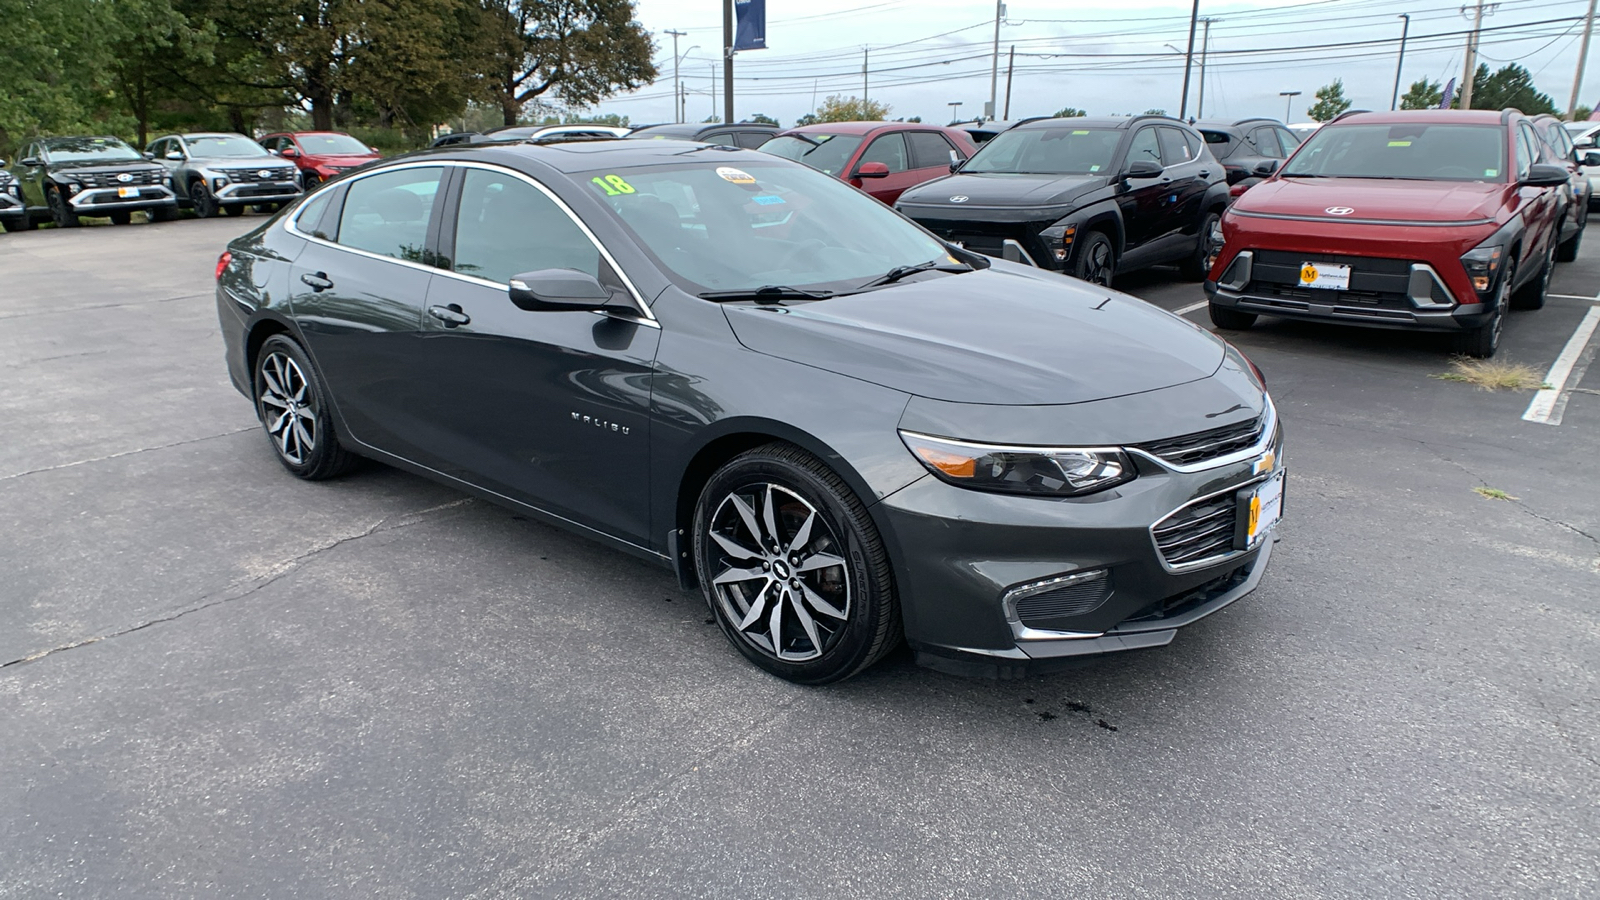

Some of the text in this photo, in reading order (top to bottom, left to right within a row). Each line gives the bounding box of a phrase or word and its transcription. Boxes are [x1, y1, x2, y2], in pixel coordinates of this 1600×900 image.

[591, 174, 636, 196] 18
[1304, 270, 1316, 279] M
[571, 411, 630, 435] MALIBU
